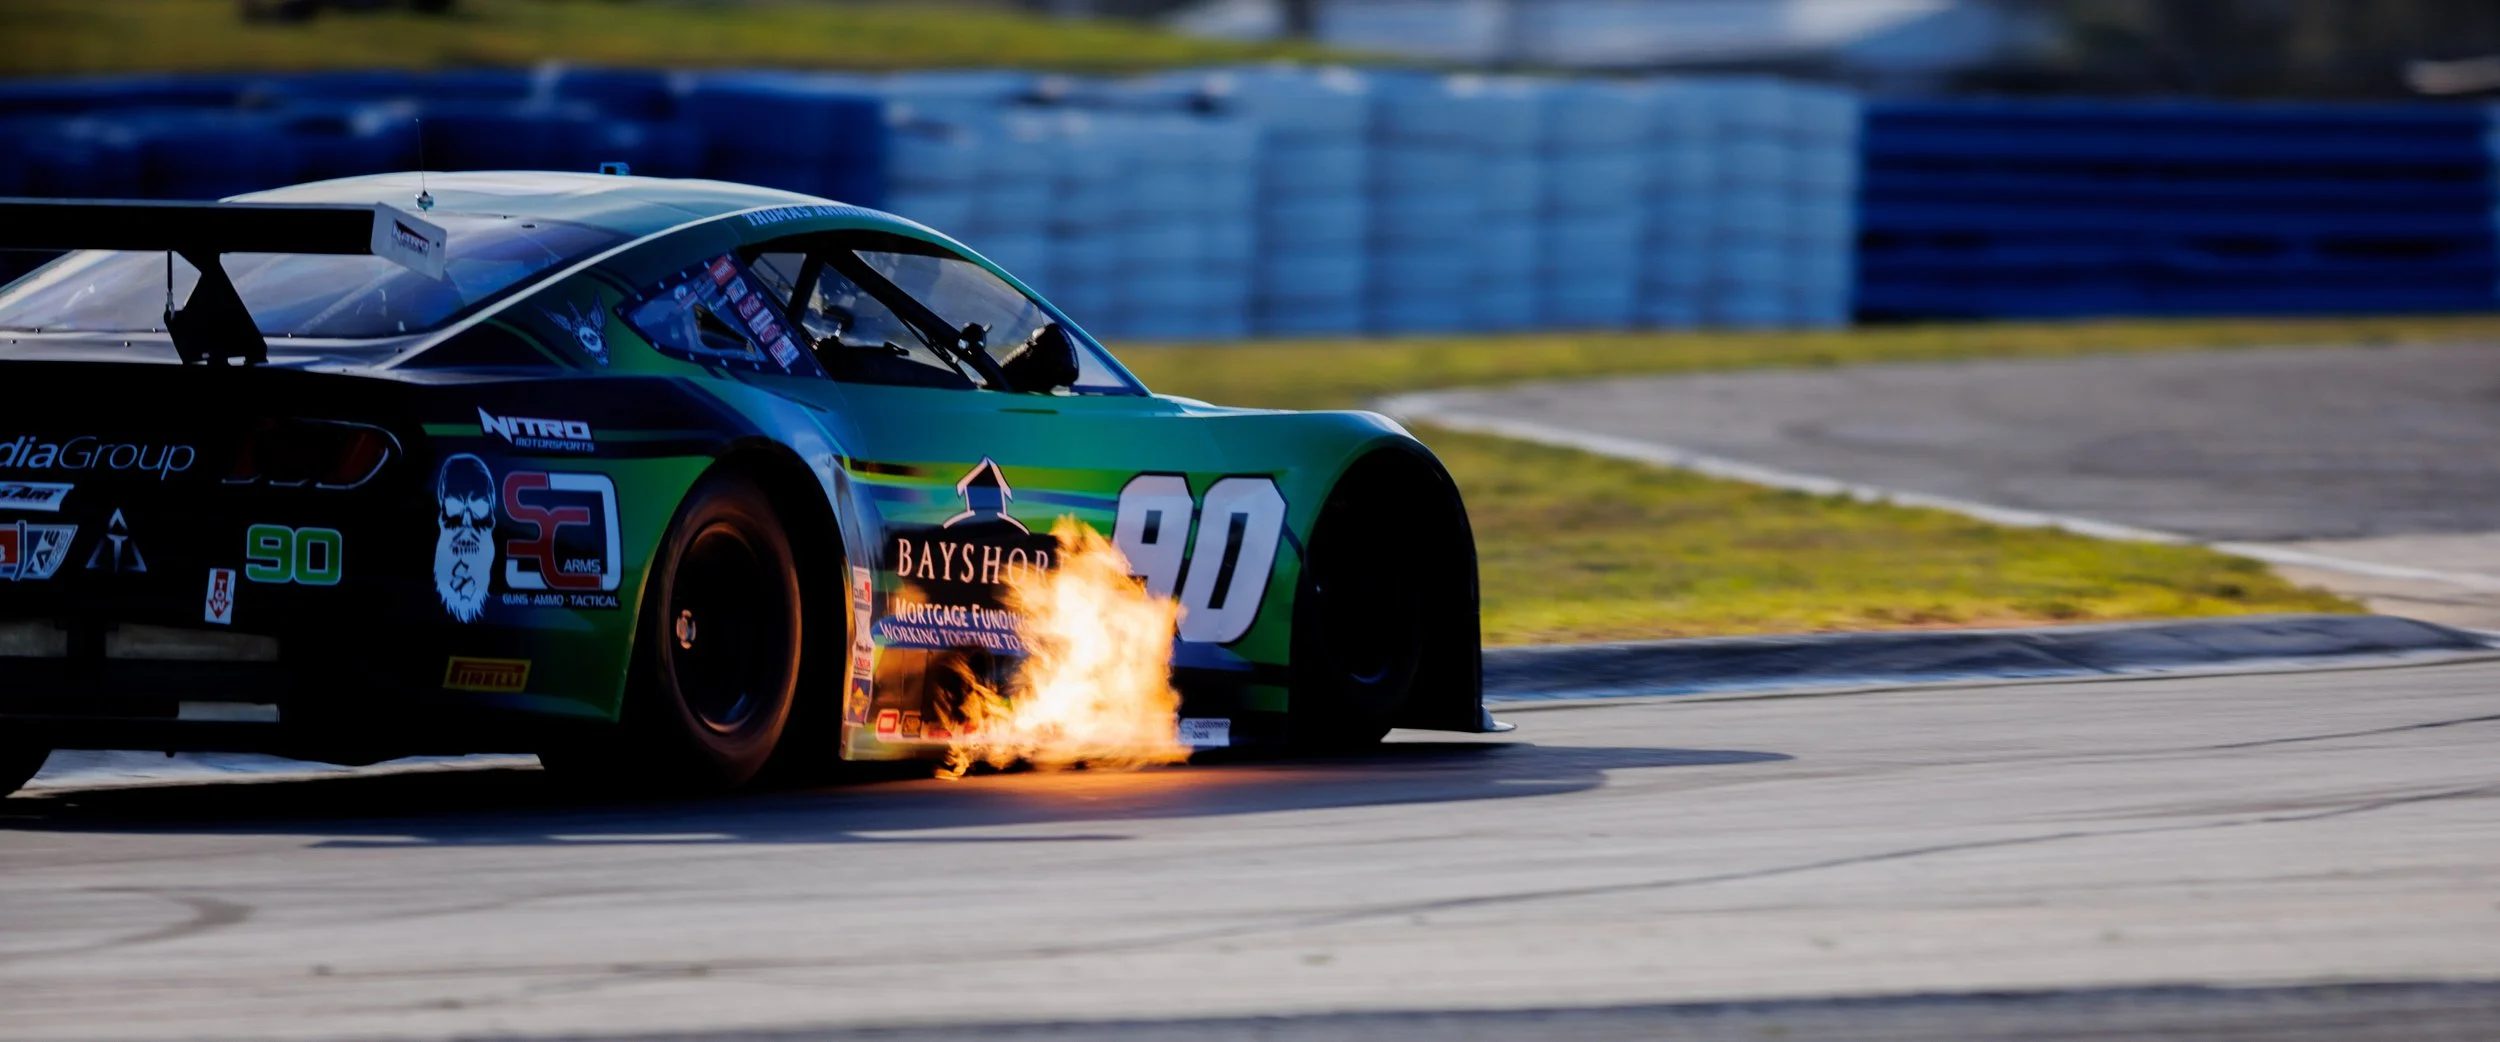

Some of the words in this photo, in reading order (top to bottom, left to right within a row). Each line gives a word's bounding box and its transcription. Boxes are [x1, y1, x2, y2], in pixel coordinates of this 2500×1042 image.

[478, 406, 592, 444] NITRO
[515, 437, 595, 452] MOTORSPORTS
[246, 524, 342, 586] 90
[563, 558, 601, 573] ARMS
[211, 578, 227, 612] TOW
[503, 593, 529, 606] GUNS
[533, 594, 564, 606] AMMO
[570, 595, 619, 607] TACTICAL
[895, 598, 969, 628] MORTGAGE
[971, 603, 1028, 632] FUNDIN
[879, 621, 941, 647] WORKING
[939, 628, 1004, 650] TOGETHER
[1001, 633, 1021, 651] TO
